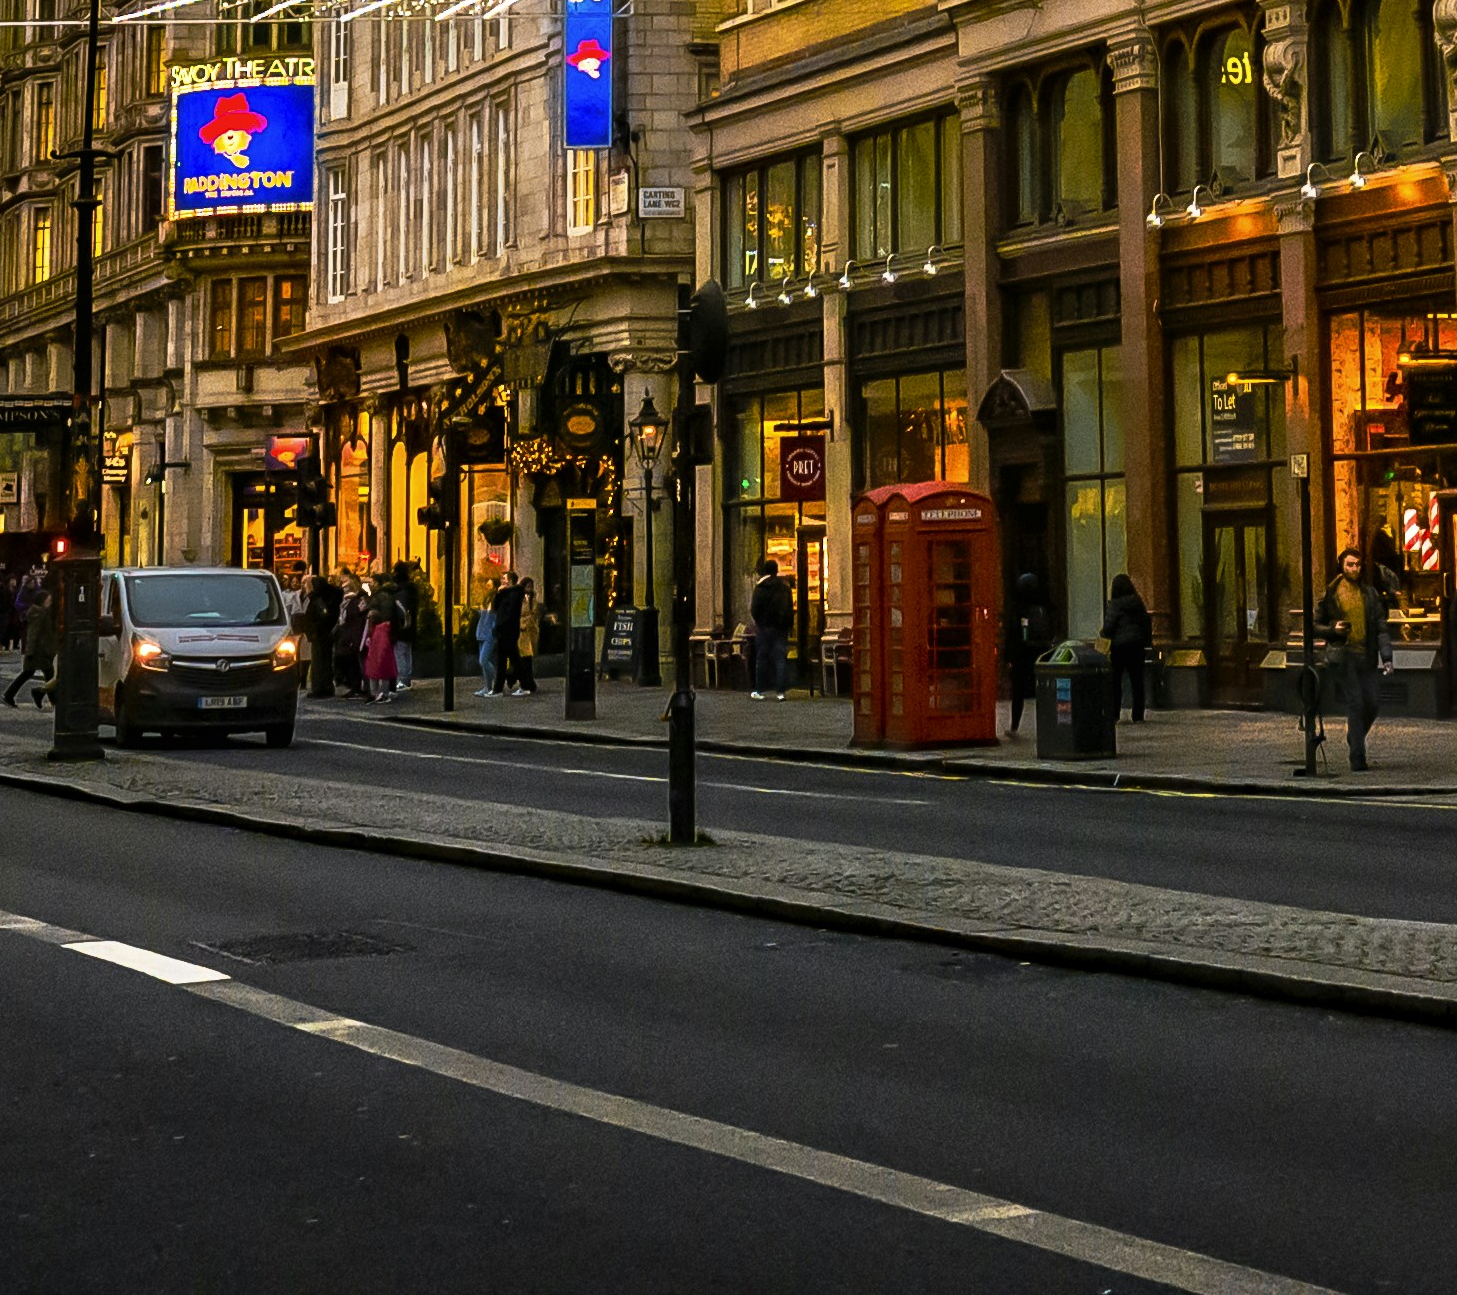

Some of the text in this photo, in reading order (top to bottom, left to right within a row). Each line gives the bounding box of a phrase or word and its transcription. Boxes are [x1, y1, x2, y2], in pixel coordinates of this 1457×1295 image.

[171, 62, 222, 87] SAVOY
[183, 170, 293, 195] PADDINGTON
[1212, 393, 1236, 410] To Let
[793, 459, 814, 475] PRET
